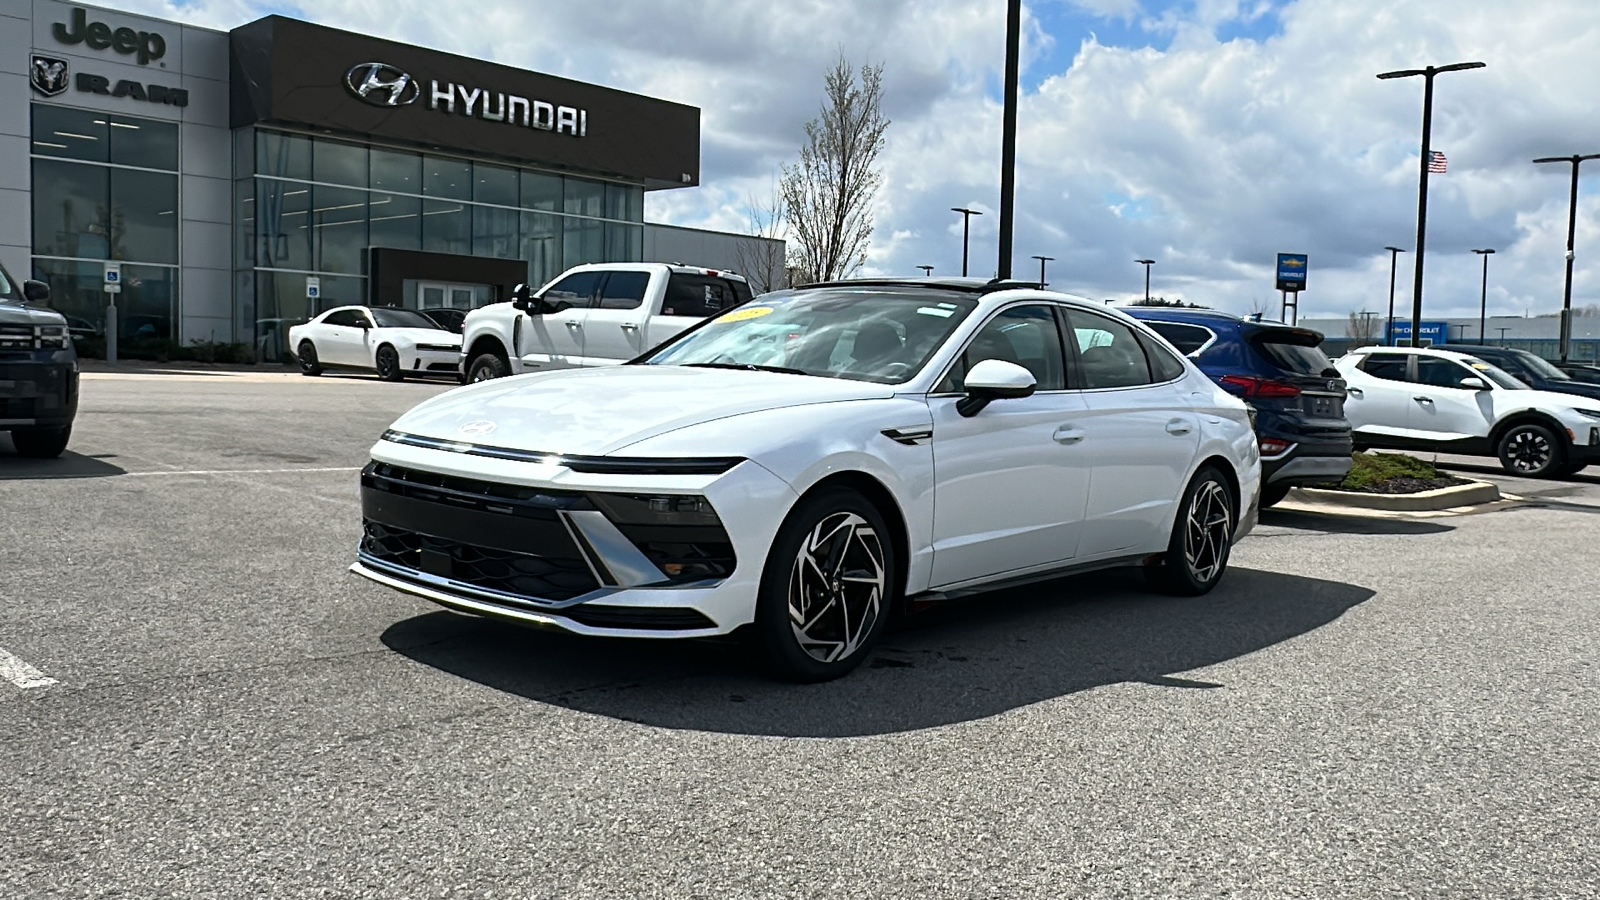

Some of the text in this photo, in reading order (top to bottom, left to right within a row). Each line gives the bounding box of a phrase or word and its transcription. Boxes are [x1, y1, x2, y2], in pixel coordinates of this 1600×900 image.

[53, 7, 166, 65] Jeep
[76, 72, 189, 107] RAM
[431, 79, 587, 137] HYUNDAI
[1403, 326, 1440, 334] CHROLET
